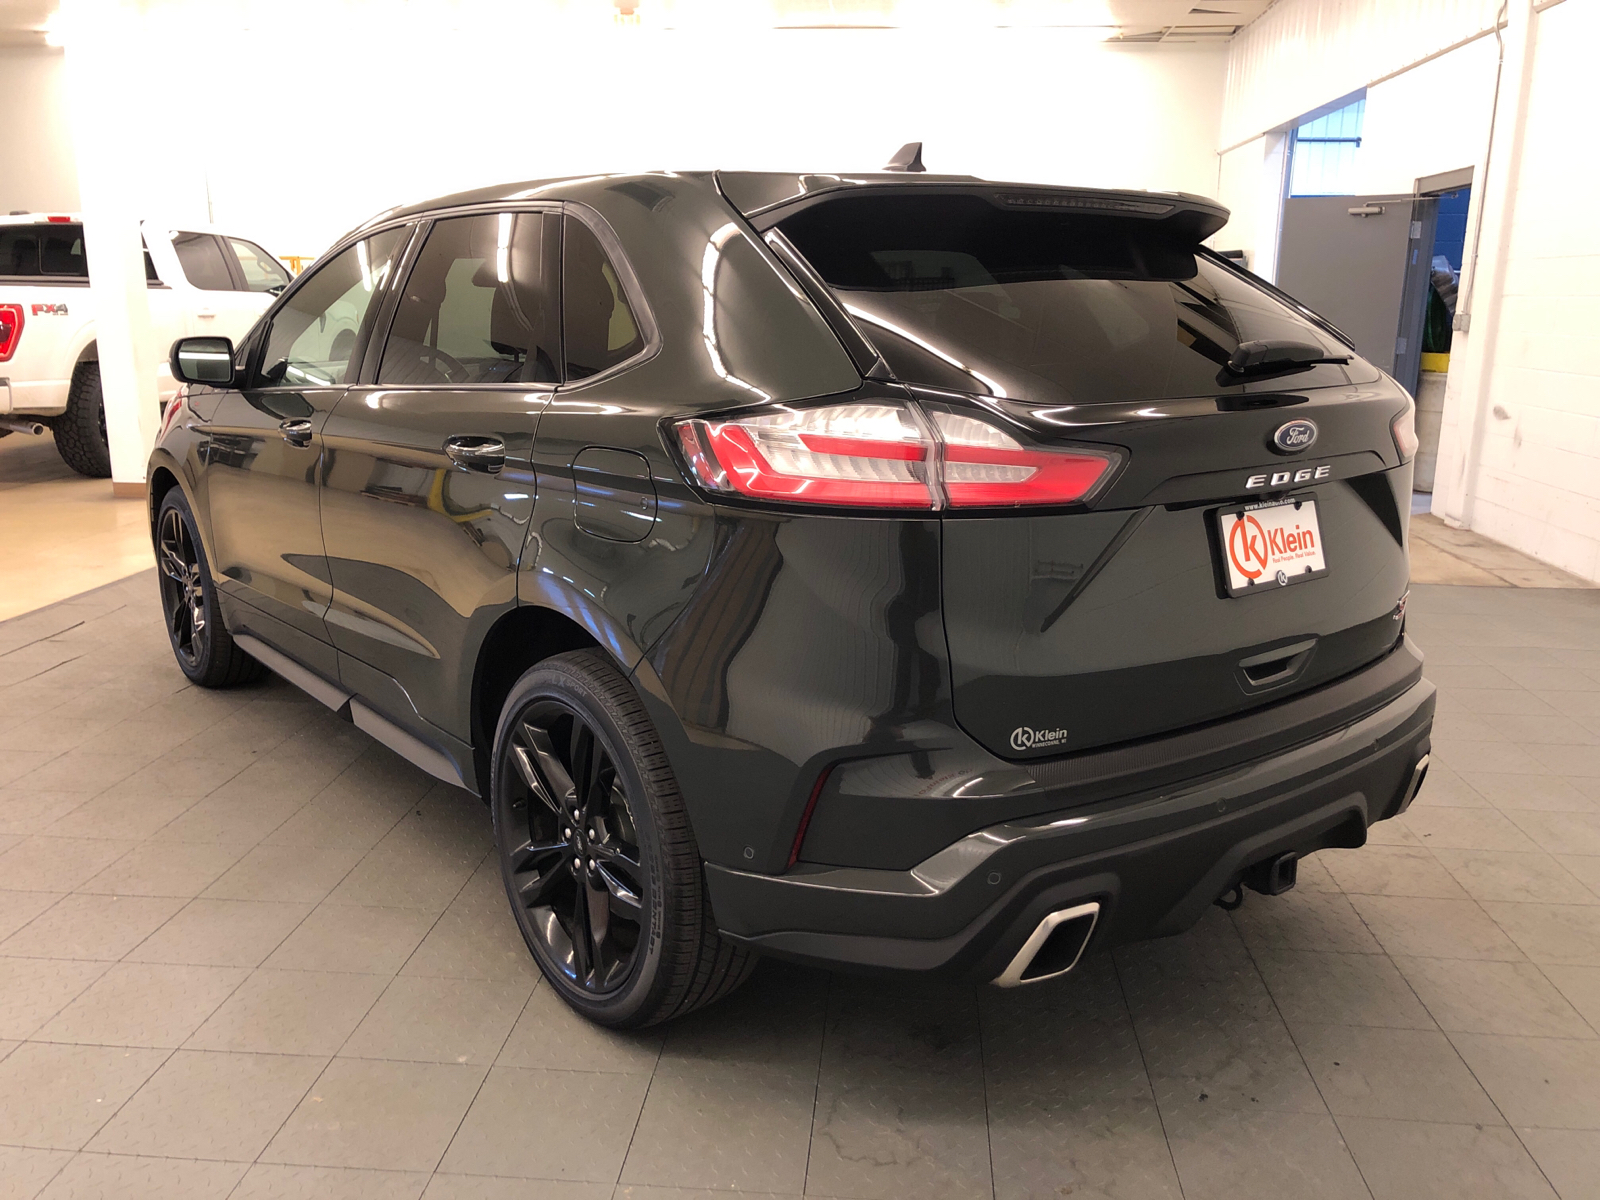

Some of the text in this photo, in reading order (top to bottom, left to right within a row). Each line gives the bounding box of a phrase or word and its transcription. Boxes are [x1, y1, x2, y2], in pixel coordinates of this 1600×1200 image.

[31, 304, 68, 316] FX4
[1286, 427, 1309, 445] Ford
[1245, 465, 1331, 489] EDGE
[1267, 524, 1315, 556] Klein
[565, 680, 588, 697] SPORT
[1035, 728, 1068, 741] Klein
